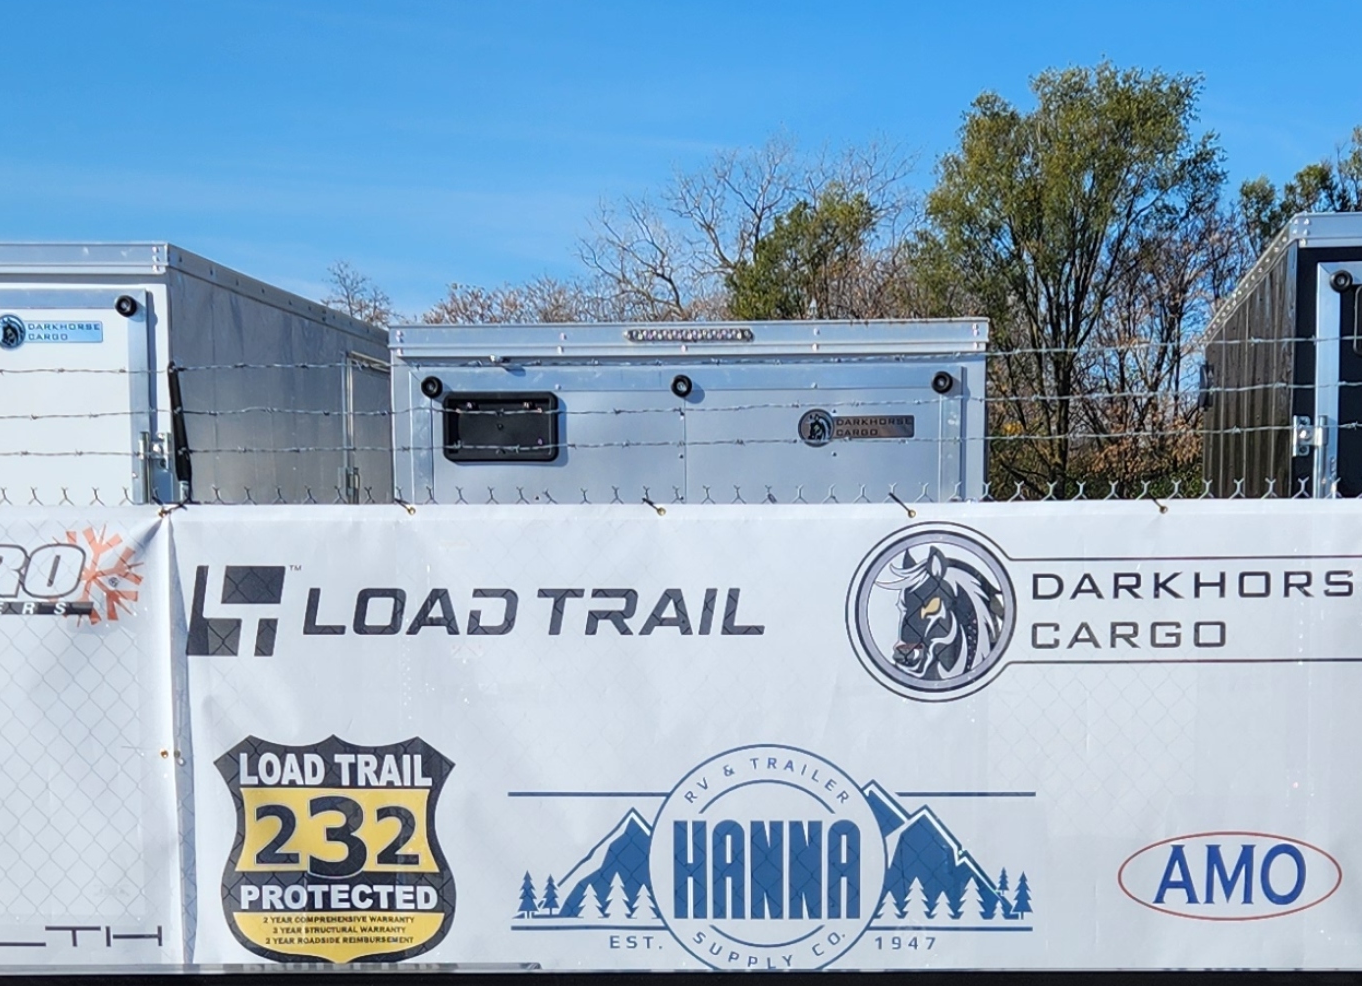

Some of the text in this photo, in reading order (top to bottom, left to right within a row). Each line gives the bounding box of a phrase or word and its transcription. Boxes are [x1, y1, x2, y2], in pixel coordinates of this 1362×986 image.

[28, 323, 100, 331] DARKHORSE
[28, 333, 68, 341] CARGO
[836, 418, 913, 427] DARKHORSE
[836, 428, 878, 437] CARGO
[303, 587, 765, 636] LOAD TRAIL
[1031, 620, 1227, 650] CARGO
[239, 752, 433, 787] LOAD TRAIL
[684, 757, 850, 804] RV & TRAILER
[254, 794, 421, 879] 232
[673, 819, 861, 920] HANNA
[1152, 843, 1307, 905] AMO
[240, 884, 439, 910] PROTECTED
[270, 916, 293, 924] YEAR
[295, 916, 368, 924] COMPREHENSIVE
[369, 916, 415, 924] WARRANTY
[279, 926, 303, 934] YEAR
[304, 926, 358, 934] STRUCTURAL
[360, 926, 406, 934] WARRANTY
[273, 936, 295, 944] YEAR
[297, 936, 340, 944] ROADSIDE
[342, 936, 414, 944] REIMBURSEMENT
[609, 935, 663, 950] EST.
[874, 936, 936, 950] 1947
[692, 931, 847, 970] SUPPLY CO.
